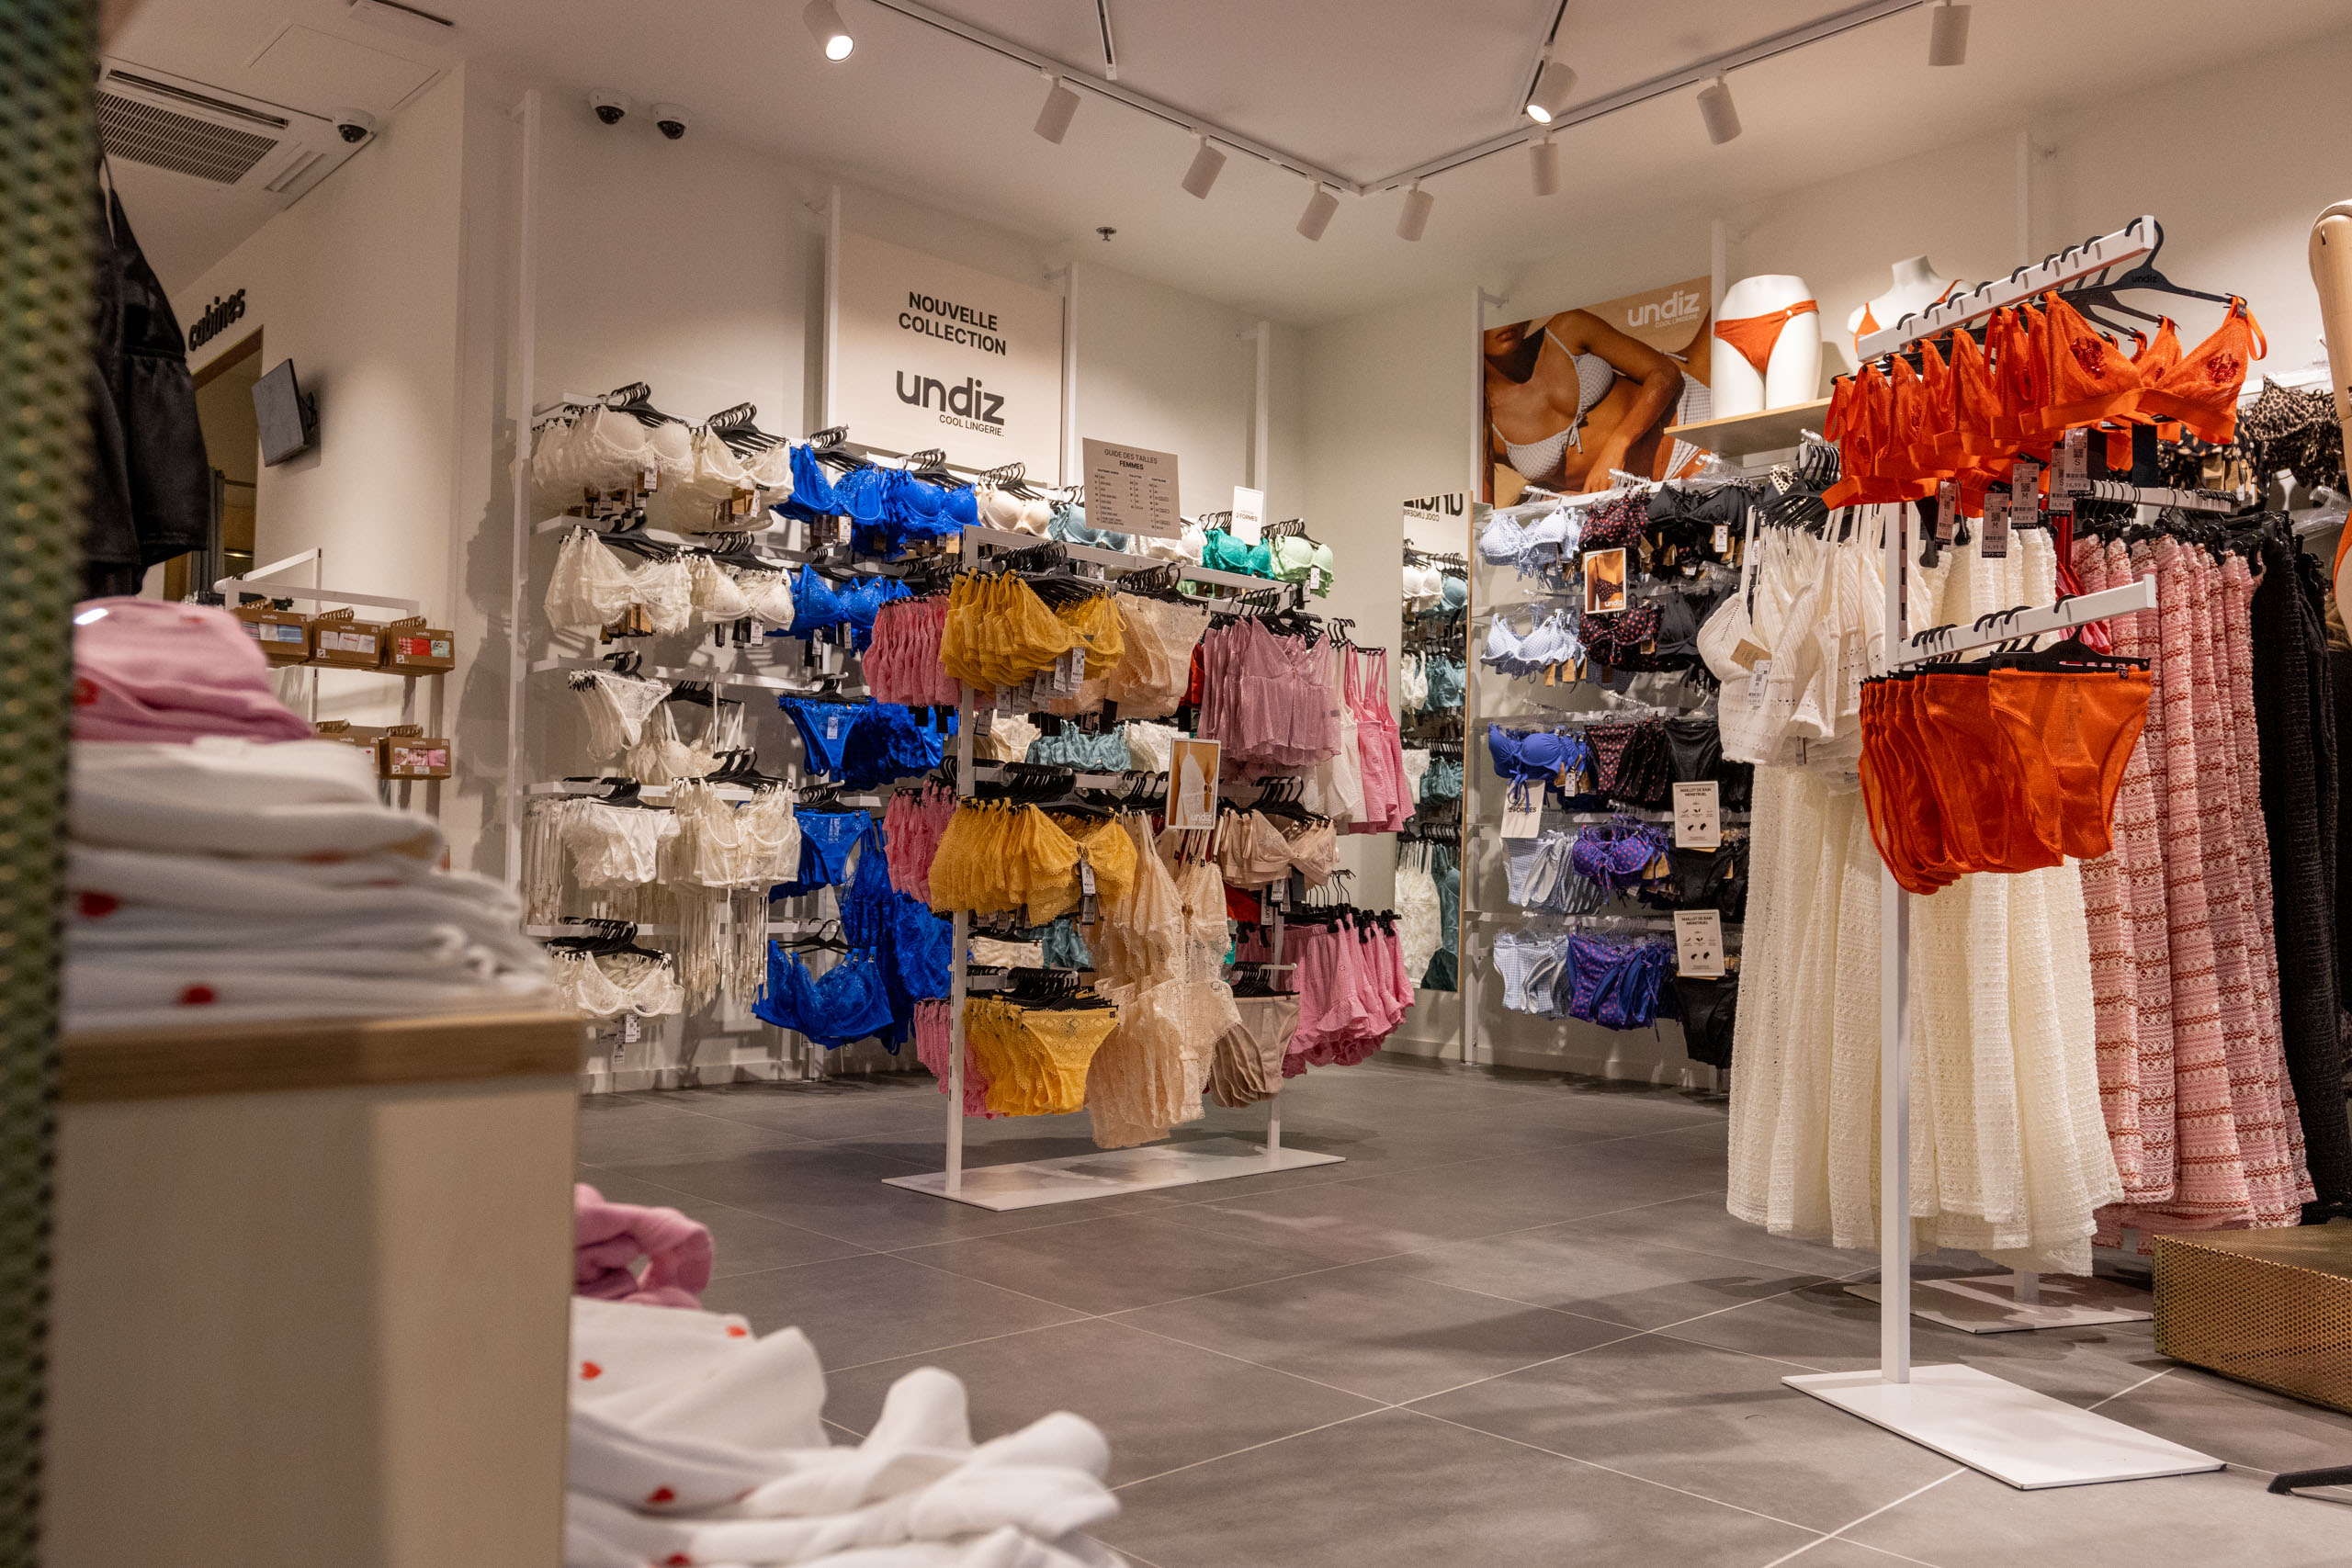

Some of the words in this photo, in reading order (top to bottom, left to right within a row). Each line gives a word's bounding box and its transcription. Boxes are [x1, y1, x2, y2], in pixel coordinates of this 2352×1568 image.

[188, 288, 245, 352] cabines
[909, 291, 998, 331] NOUVELLE
[1627, 290, 1700, 327] undiz
[899, 312, 1006, 355] COLLECTION
[896, 370, 1005, 425] undiz
[939, 414, 964, 427] COOL
[965, 420, 1004, 437] LINGERIE.
[1104, 448, 1123, 458] GUIDE
[1135, 454, 1158, 464] TAILLES
[1119, 460, 1144, 470] FEMMES
[1239, 513, 1258, 522] FORMES
